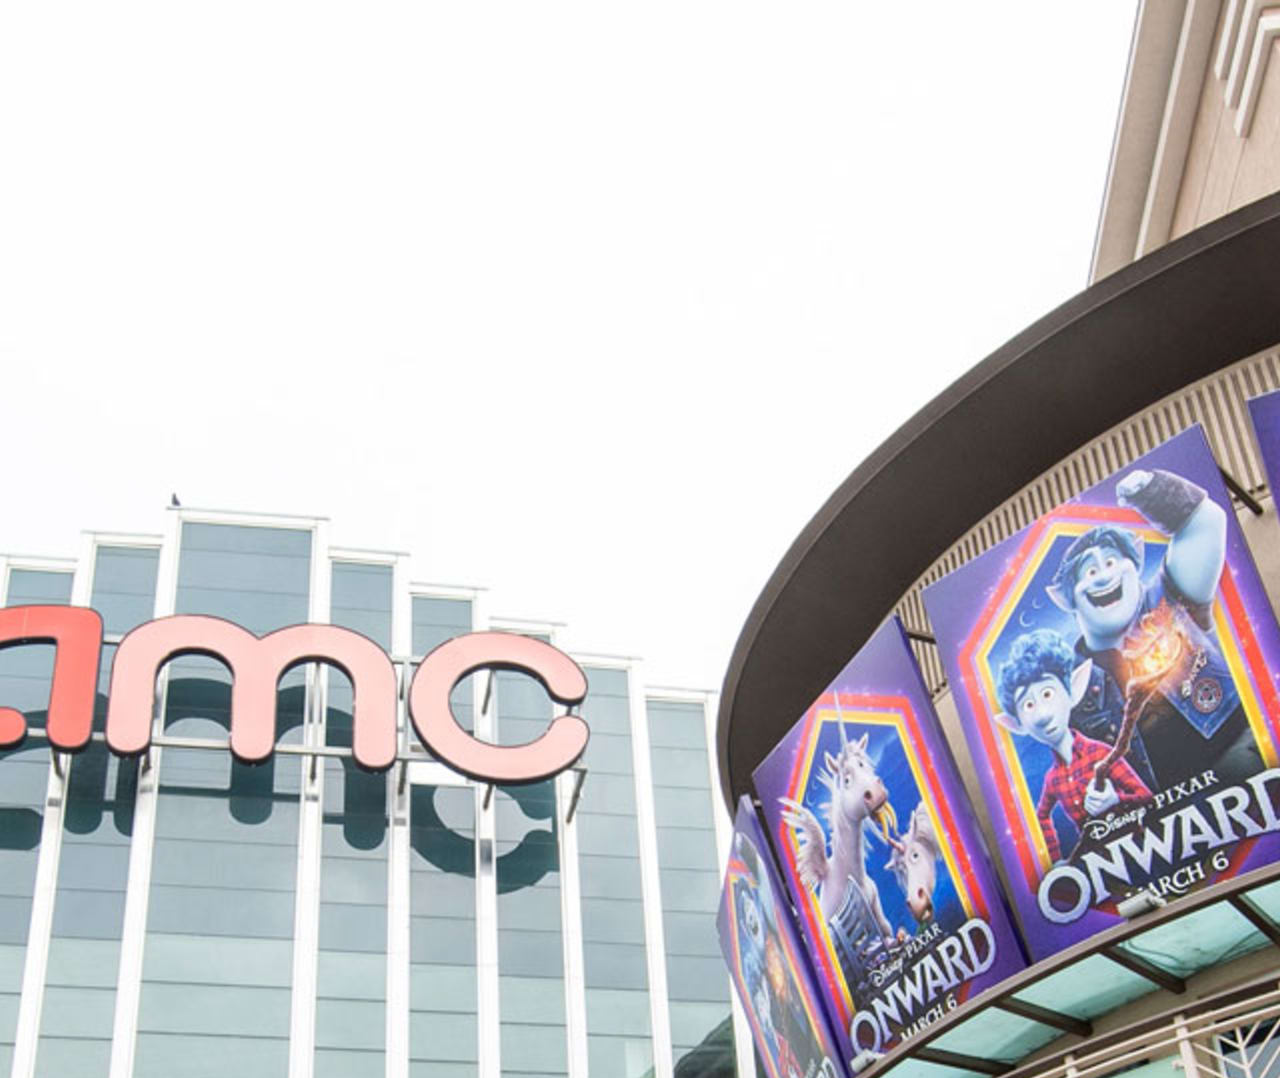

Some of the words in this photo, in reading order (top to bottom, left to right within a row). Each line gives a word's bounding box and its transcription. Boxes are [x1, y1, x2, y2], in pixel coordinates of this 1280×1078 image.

[1153, 769, 1219, 809] PIXAR
[1125, 861, 1206, 898] ARCH
[1211, 850, 1230, 871] 6
[905, 922, 942, 959] PIXAR
[851, 918, 996, 1056] ONWARD
[946, 993, 958, 1010] 6
